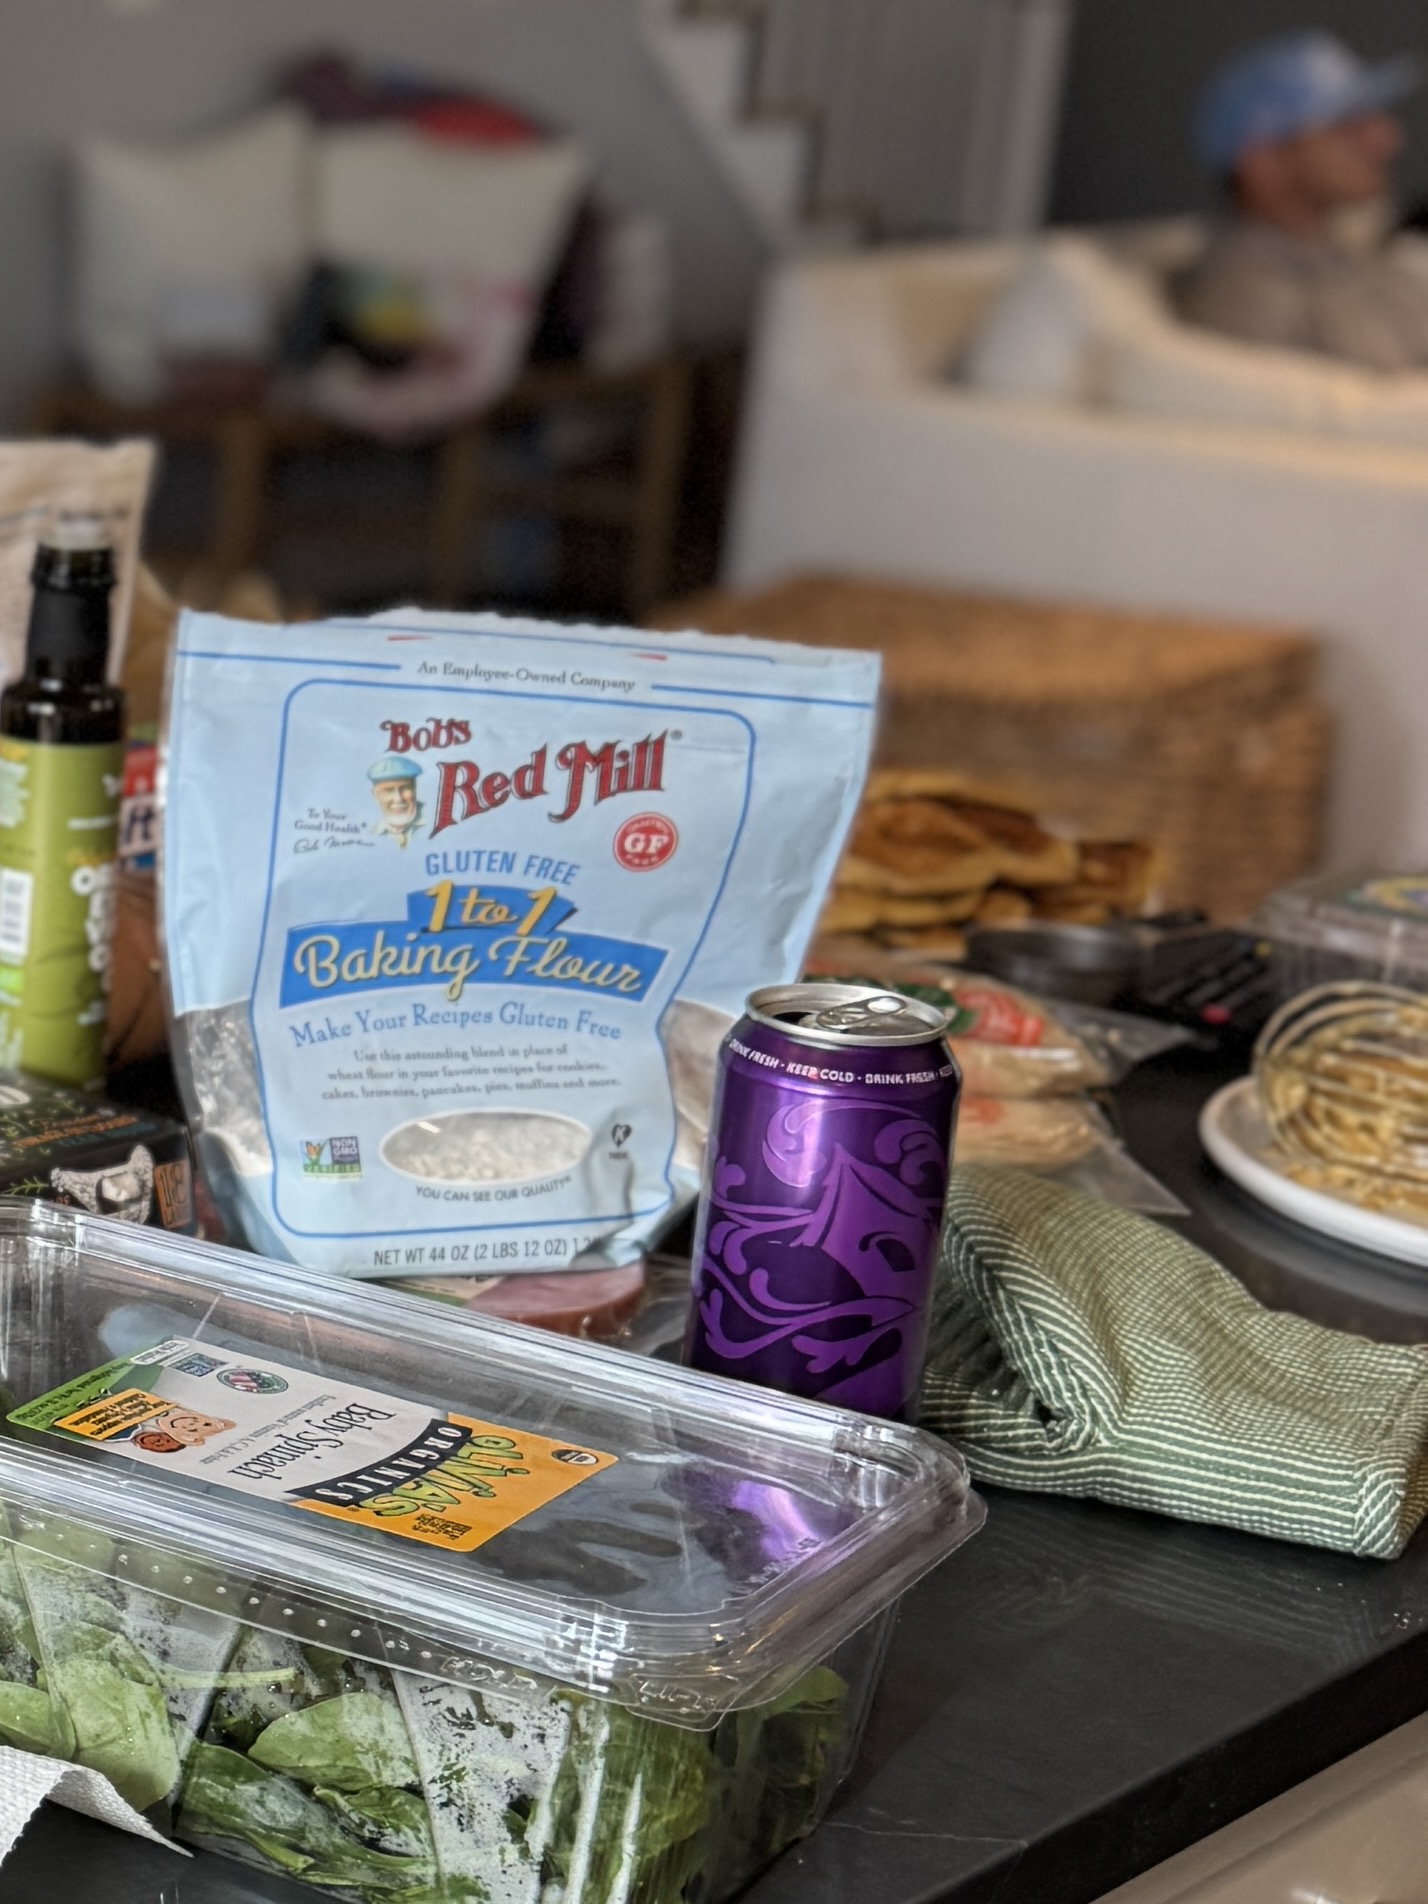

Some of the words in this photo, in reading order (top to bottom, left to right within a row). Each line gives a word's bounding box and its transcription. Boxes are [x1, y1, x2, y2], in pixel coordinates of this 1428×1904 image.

[417, 661, 437, 674] An
[443, 662, 566, 687] Employee-Owned
[571, 671, 635, 692] Company
[429, 742, 549, 839] Red
[547, 728, 668, 824] Mill
[294, 820, 322, 830] Good
[308, 808, 320, 818] To
[323, 809, 346, 820] Your
[624, 832, 669, 853] GF
[426, 850, 514, 875] GLUTEN
[523, 853, 580, 885] FREE
[425, 880, 454, 933] 1
[459, 888, 518, 925] to
[516, 886, 557, 937] 1
[293, 930, 481, 1002] Baking
[487, 935, 641, 993] Flour
[291, 1020, 352, 1048] Make
[355, 1009, 406, 1033] Your
[413, 1003, 493, 1029] Recipes
[499, 1002, 569, 1031] Gluten
[575, 1010, 622, 1040] Free
[354, 1050, 376, 1063] Use
[380, 1049, 400, 1062] this
[404, 1048, 469, 1062] astounding
[471, 1046, 505, 1059] blend
[508, 1046, 520, 1057] in
[523, 1046, 555, 1060] place
[556, 1044, 569, 1056] of
[748, 1050, 779, 1069] FRESH
[786, 1062, 819, 1080] KEEP
[820, 1069, 854, 1083] COLD
[865, 1073, 904, 1084] DRINK
[906, 1072, 935, 1083] FRESH
[328, 1069, 362, 1081] wheat
[364, 1067, 396, 1080] flour
[397, 1068, 409, 1080] in
[412, 1070, 439, 1083] your
[441, 1064, 490, 1078] favorite
[492, 1064, 534, 1078] recipes
[535, 1062, 554, 1074] for
[515, 1078, 561, 1092] muffins
[563, 1076, 585, 1089] and
[587, 1077, 621, 1088] more.
[416, 1186, 440, 1201] YOU
[444, 1190, 470, 1202] CAN
[472, 1190, 492, 1202] SEE
[494, 1188, 519, 1201] OUR
[374, 1250, 399, 1266] NET
[405, 1249, 424, 1264] WT
[429, 1247, 446, 1261] 44
[451, 1245, 469, 1260] OZ
[473, 1243, 489, 1261] (2
[492, 1242, 518, 1258] LBS
[524, 1241, 540, 1257] 12
[544, 1239, 568, 1257] OZ)
[308, 1403, 397, 1449] Baby
[227, 1427, 344, 1481] Spinach
[316, 1427, 471, 1502] ORGANICS
